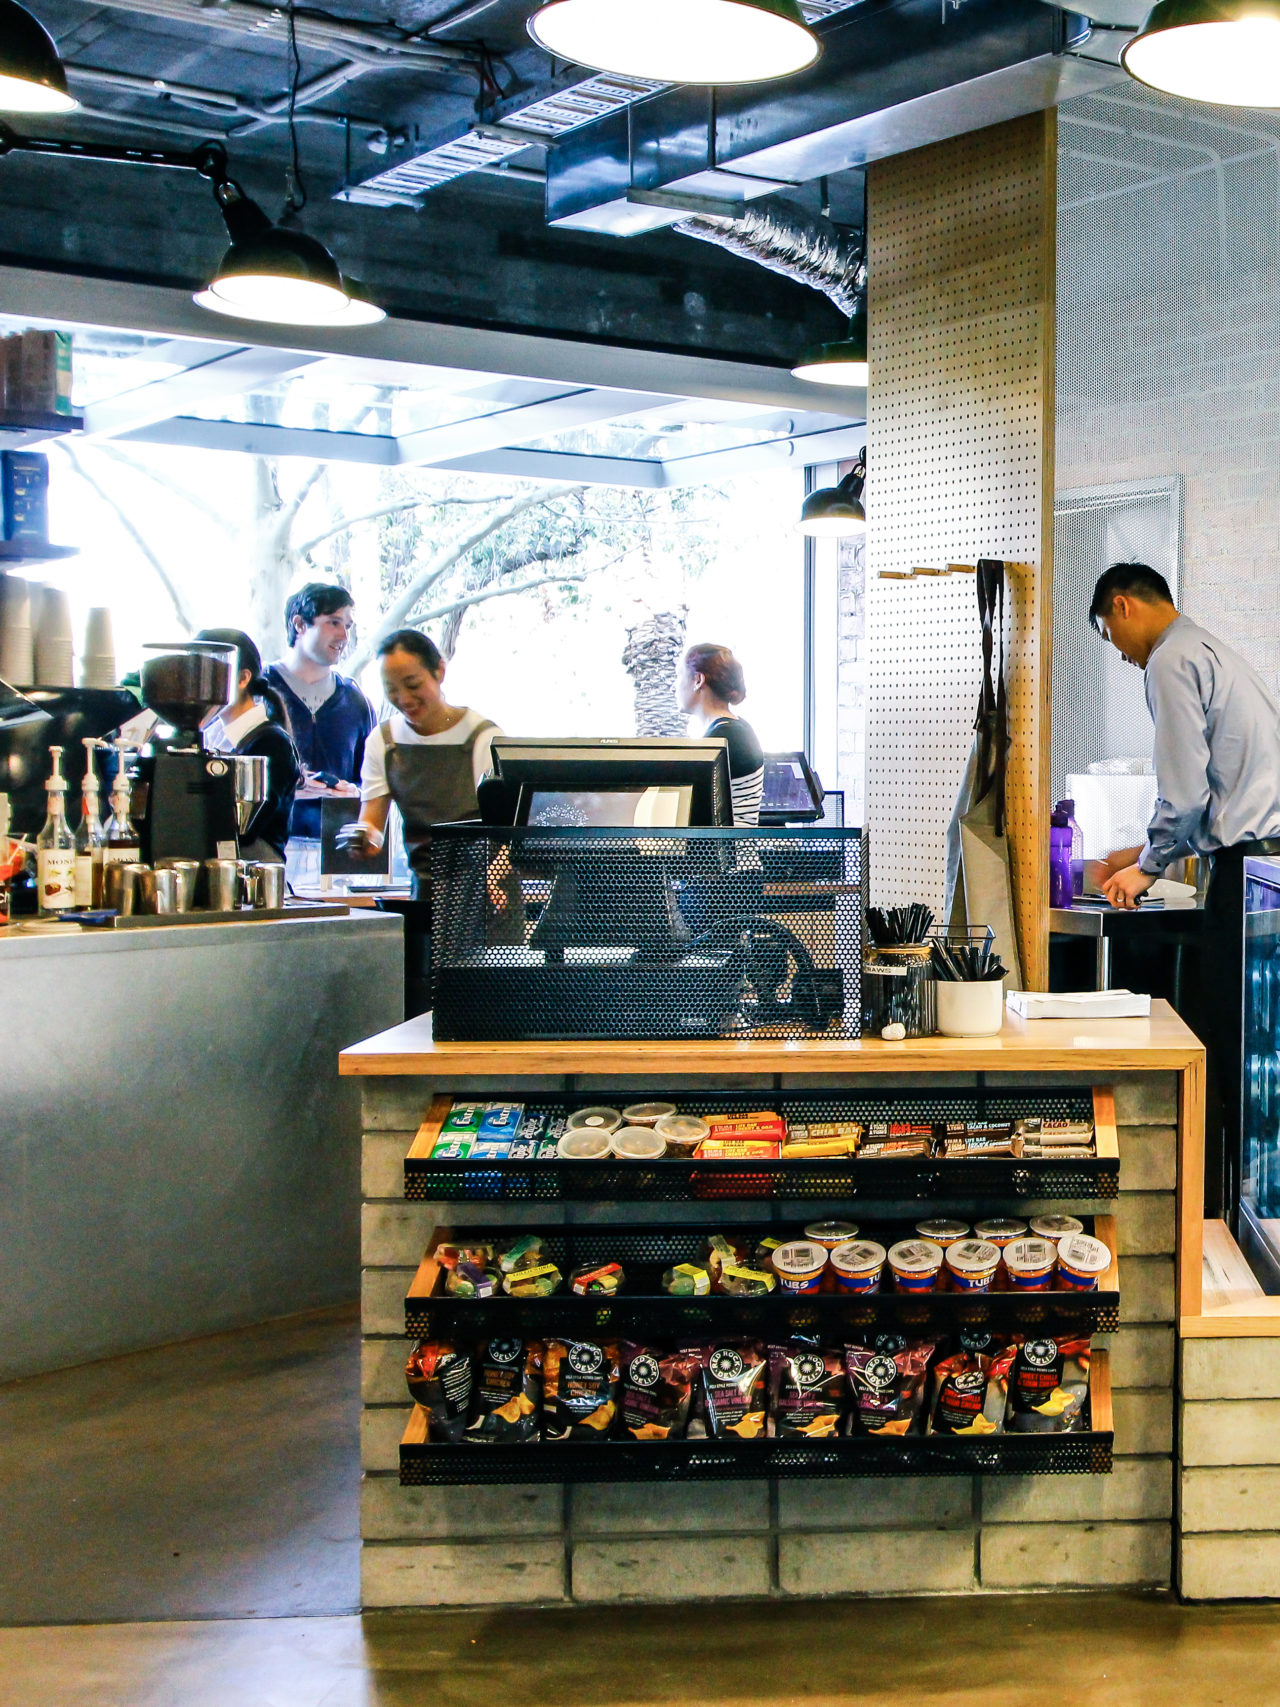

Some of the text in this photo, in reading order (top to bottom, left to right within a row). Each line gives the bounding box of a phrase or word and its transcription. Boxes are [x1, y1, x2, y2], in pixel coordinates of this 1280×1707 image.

[456, 1106, 476, 1124] Extra
[493, 1105, 512, 1124] Extra
[838, 1126, 859, 1134] BAR
[442, 1137, 462, 1157] Extra
[780, 1278, 809, 1289] TUBS
[493, 1350, 512, 1361] DELI
[570, 1345, 582, 1360] RED
[574, 1361, 597, 1371] DELI
[631, 1356, 645, 1370] RED
[711, 1351, 740, 1369] RED ROCK
[807, 1355, 822, 1374] ROCK
[1030, 1356, 1050, 1364] DELI
[868, 1359, 880, 1376] RED
[633, 1375, 652, 1385] DELI
[717, 1371, 738, 1379] DELI
[870, 1375, 890, 1386] DELI
